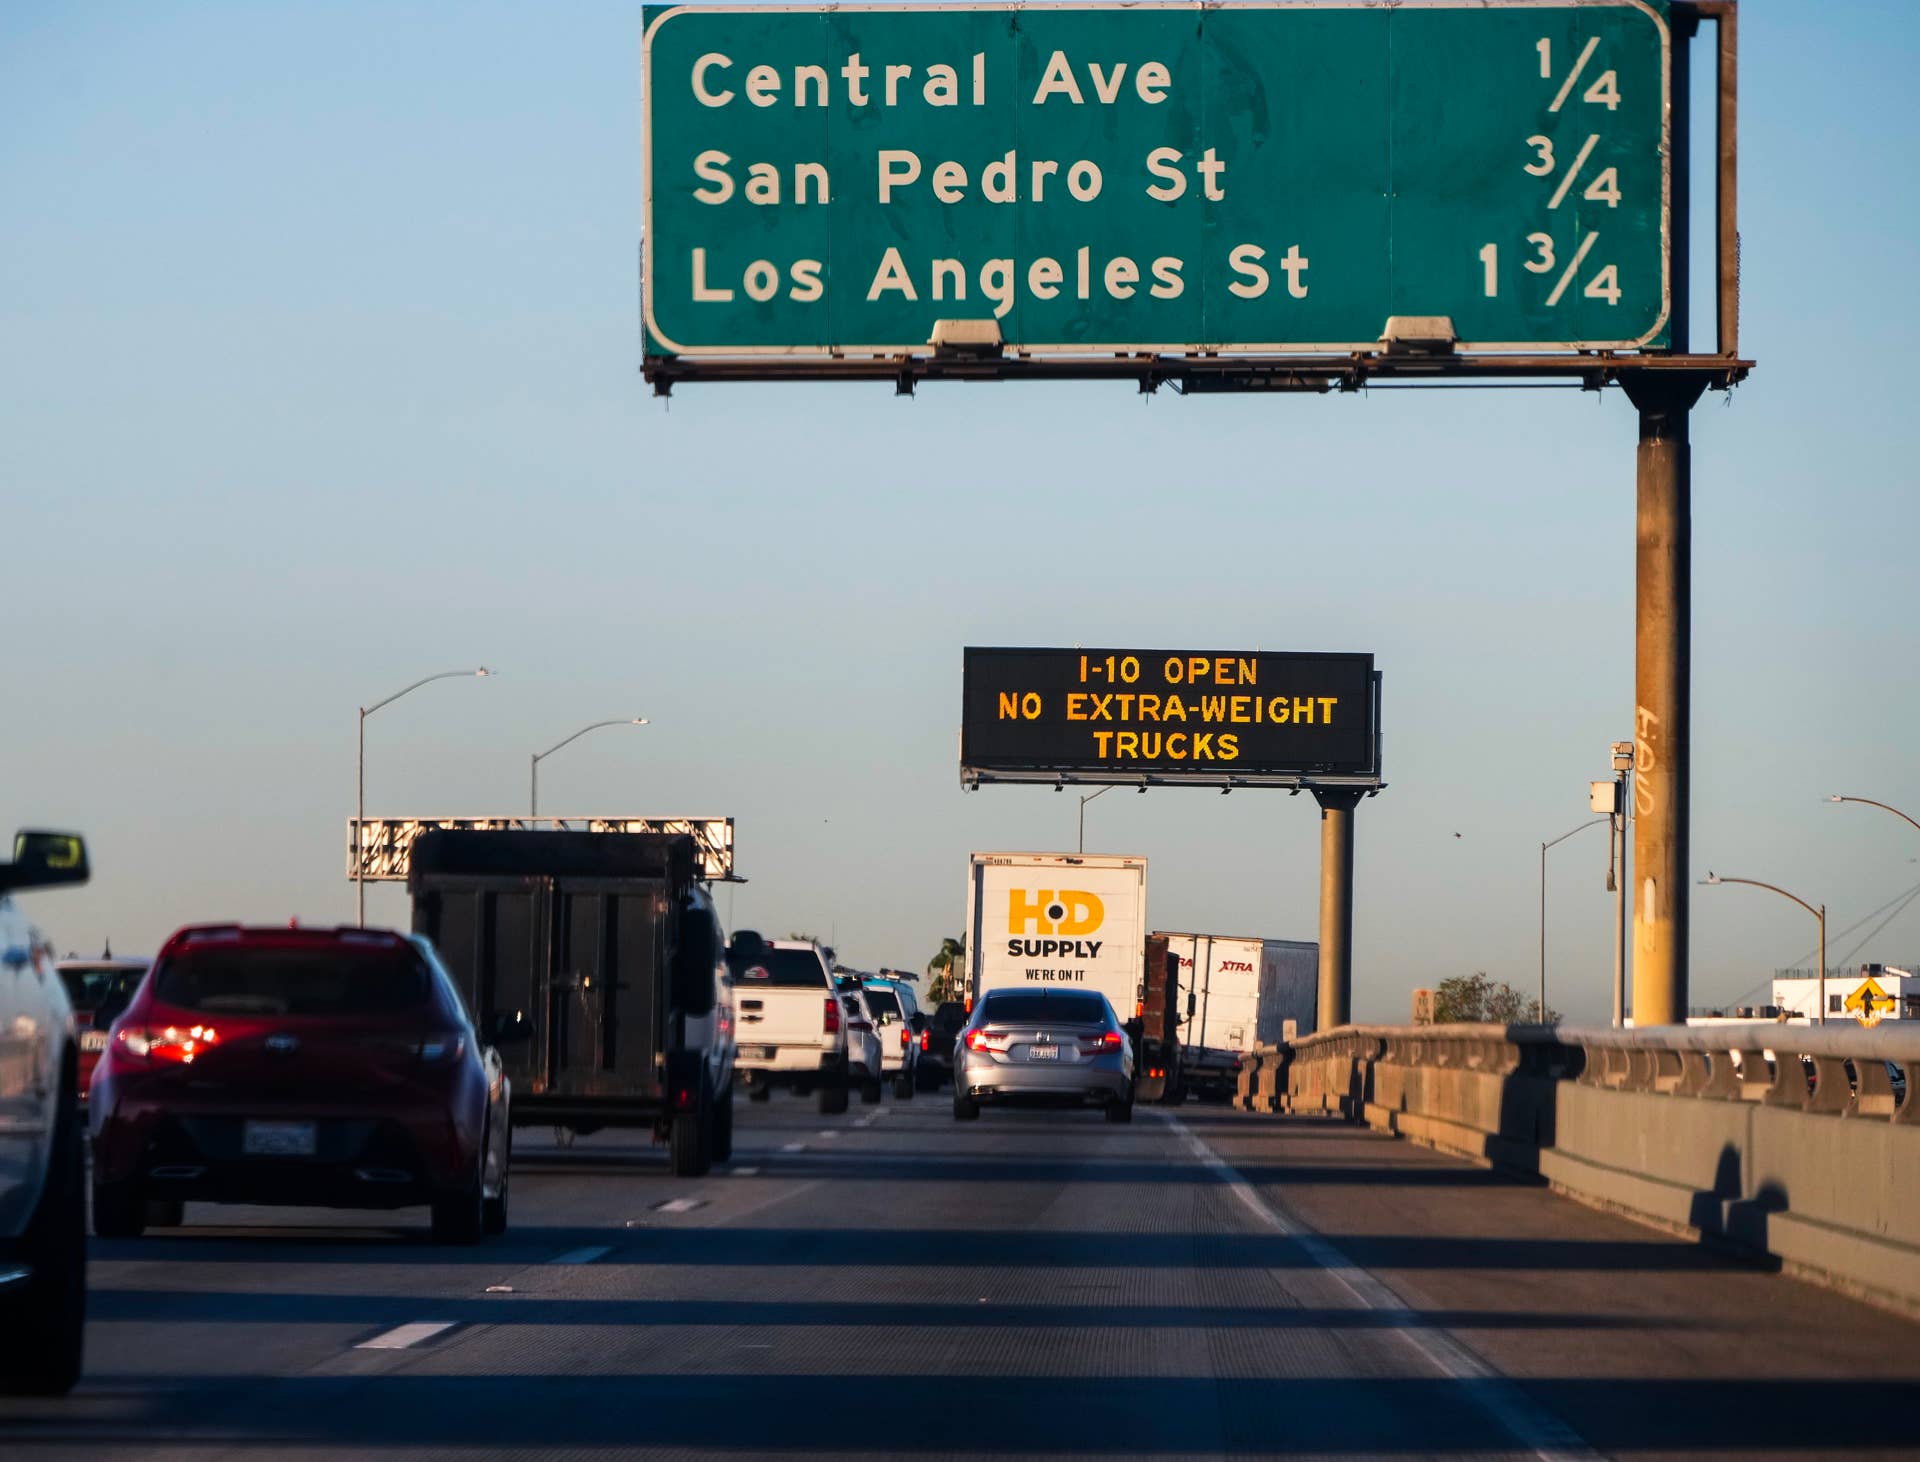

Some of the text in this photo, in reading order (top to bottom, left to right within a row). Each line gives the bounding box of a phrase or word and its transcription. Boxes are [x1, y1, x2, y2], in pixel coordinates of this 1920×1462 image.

[692, 52, 985, 108] Central
[1032, 50, 1172, 105] Ave
[692, 149, 830, 205] San
[878, 149, 1103, 204] Pedro
[1145, 147, 1225, 202] St
[692, 247, 824, 302] Los
[866, 246, 1185, 319] Angeles
[1228, 243, 1309, 299] St
[1080, 656, 1257, 685] I-10 OPEN
[999, 691, 1338, 724] NO EXTRA-WEIGHT
[1093, 731, 1239, 760] TRUCKS
[1008, 888, 1105, 936] HD
[1008, 939, 1103, 958] SUPPLY
[1025, 968, 1085, 982] WE'RE ON IT
[1218, 960, 1253, 972] XTRA
